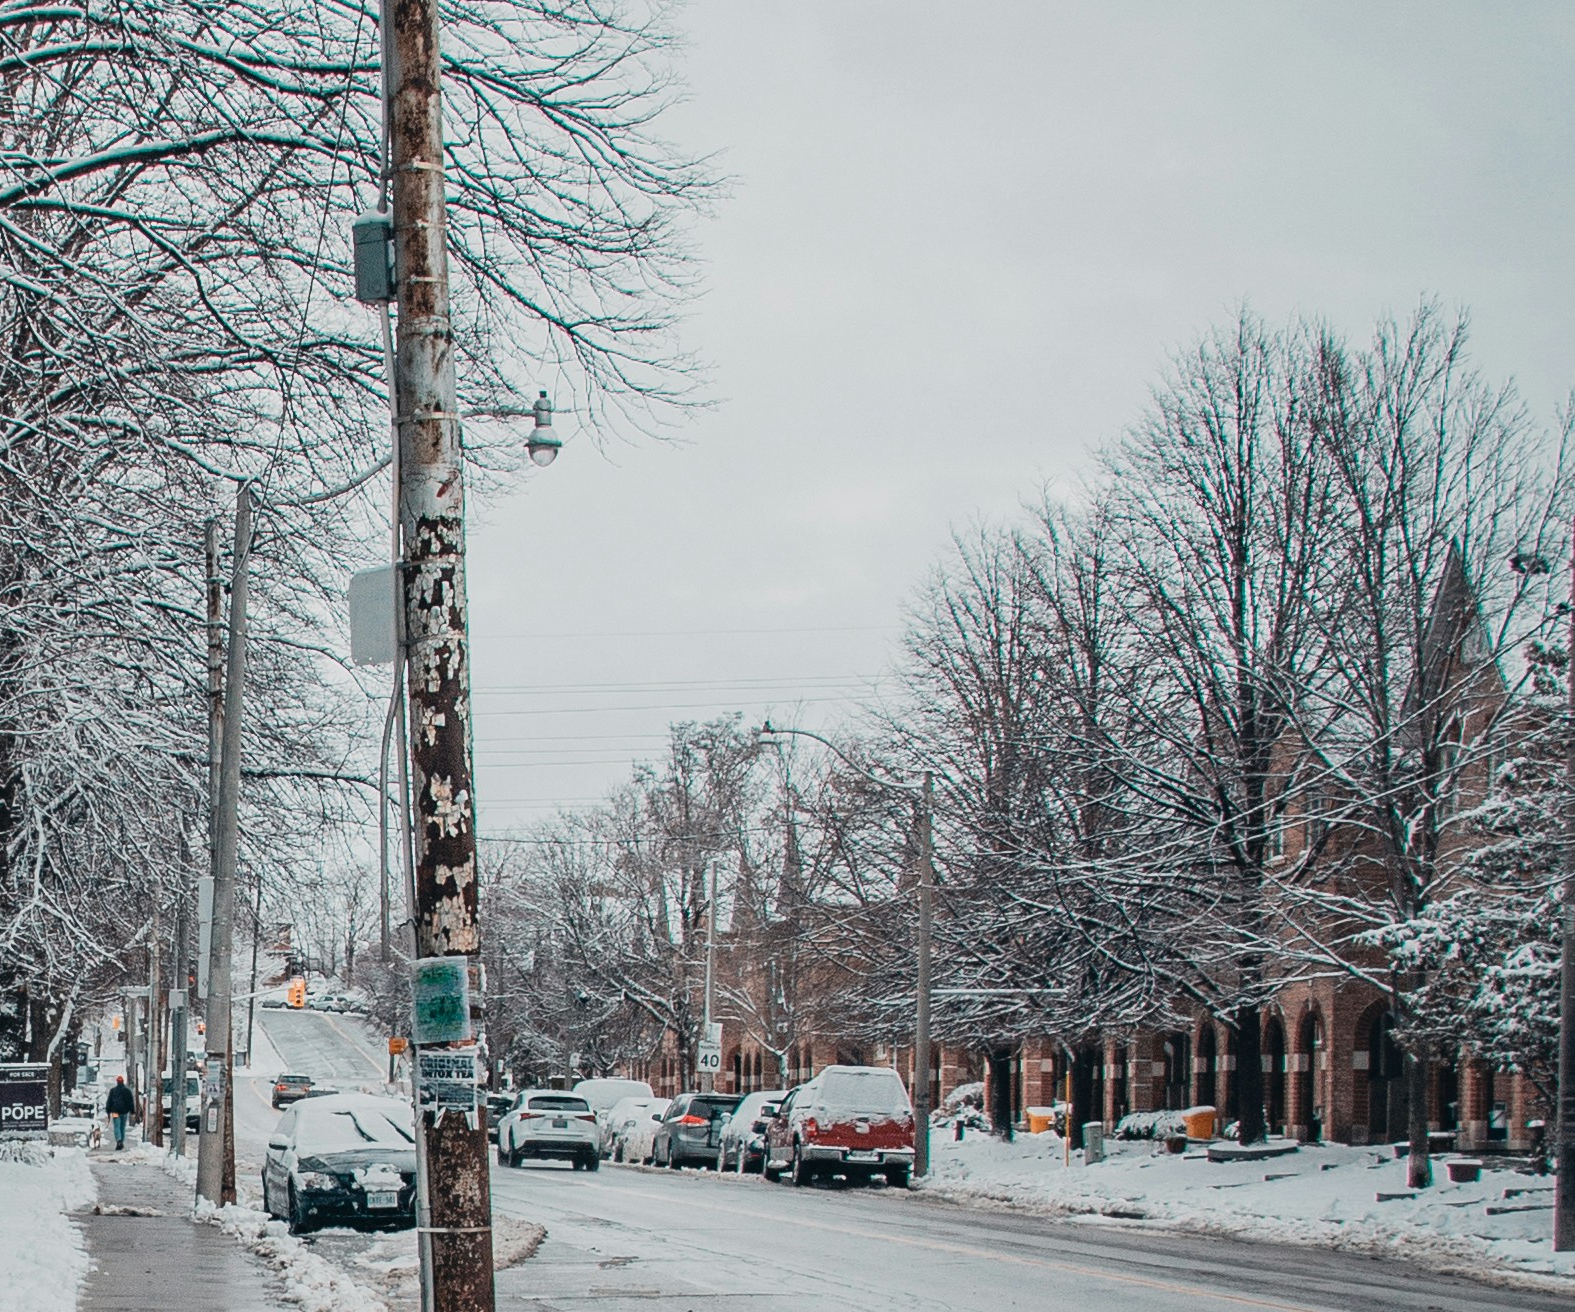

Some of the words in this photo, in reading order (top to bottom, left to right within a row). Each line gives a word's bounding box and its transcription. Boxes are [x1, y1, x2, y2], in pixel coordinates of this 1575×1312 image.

[419, 1057, 474, 1069] ORIGINAL
[700, 1053, 720, 1067] 40
[454, 1069, 474, 1079] TEA
